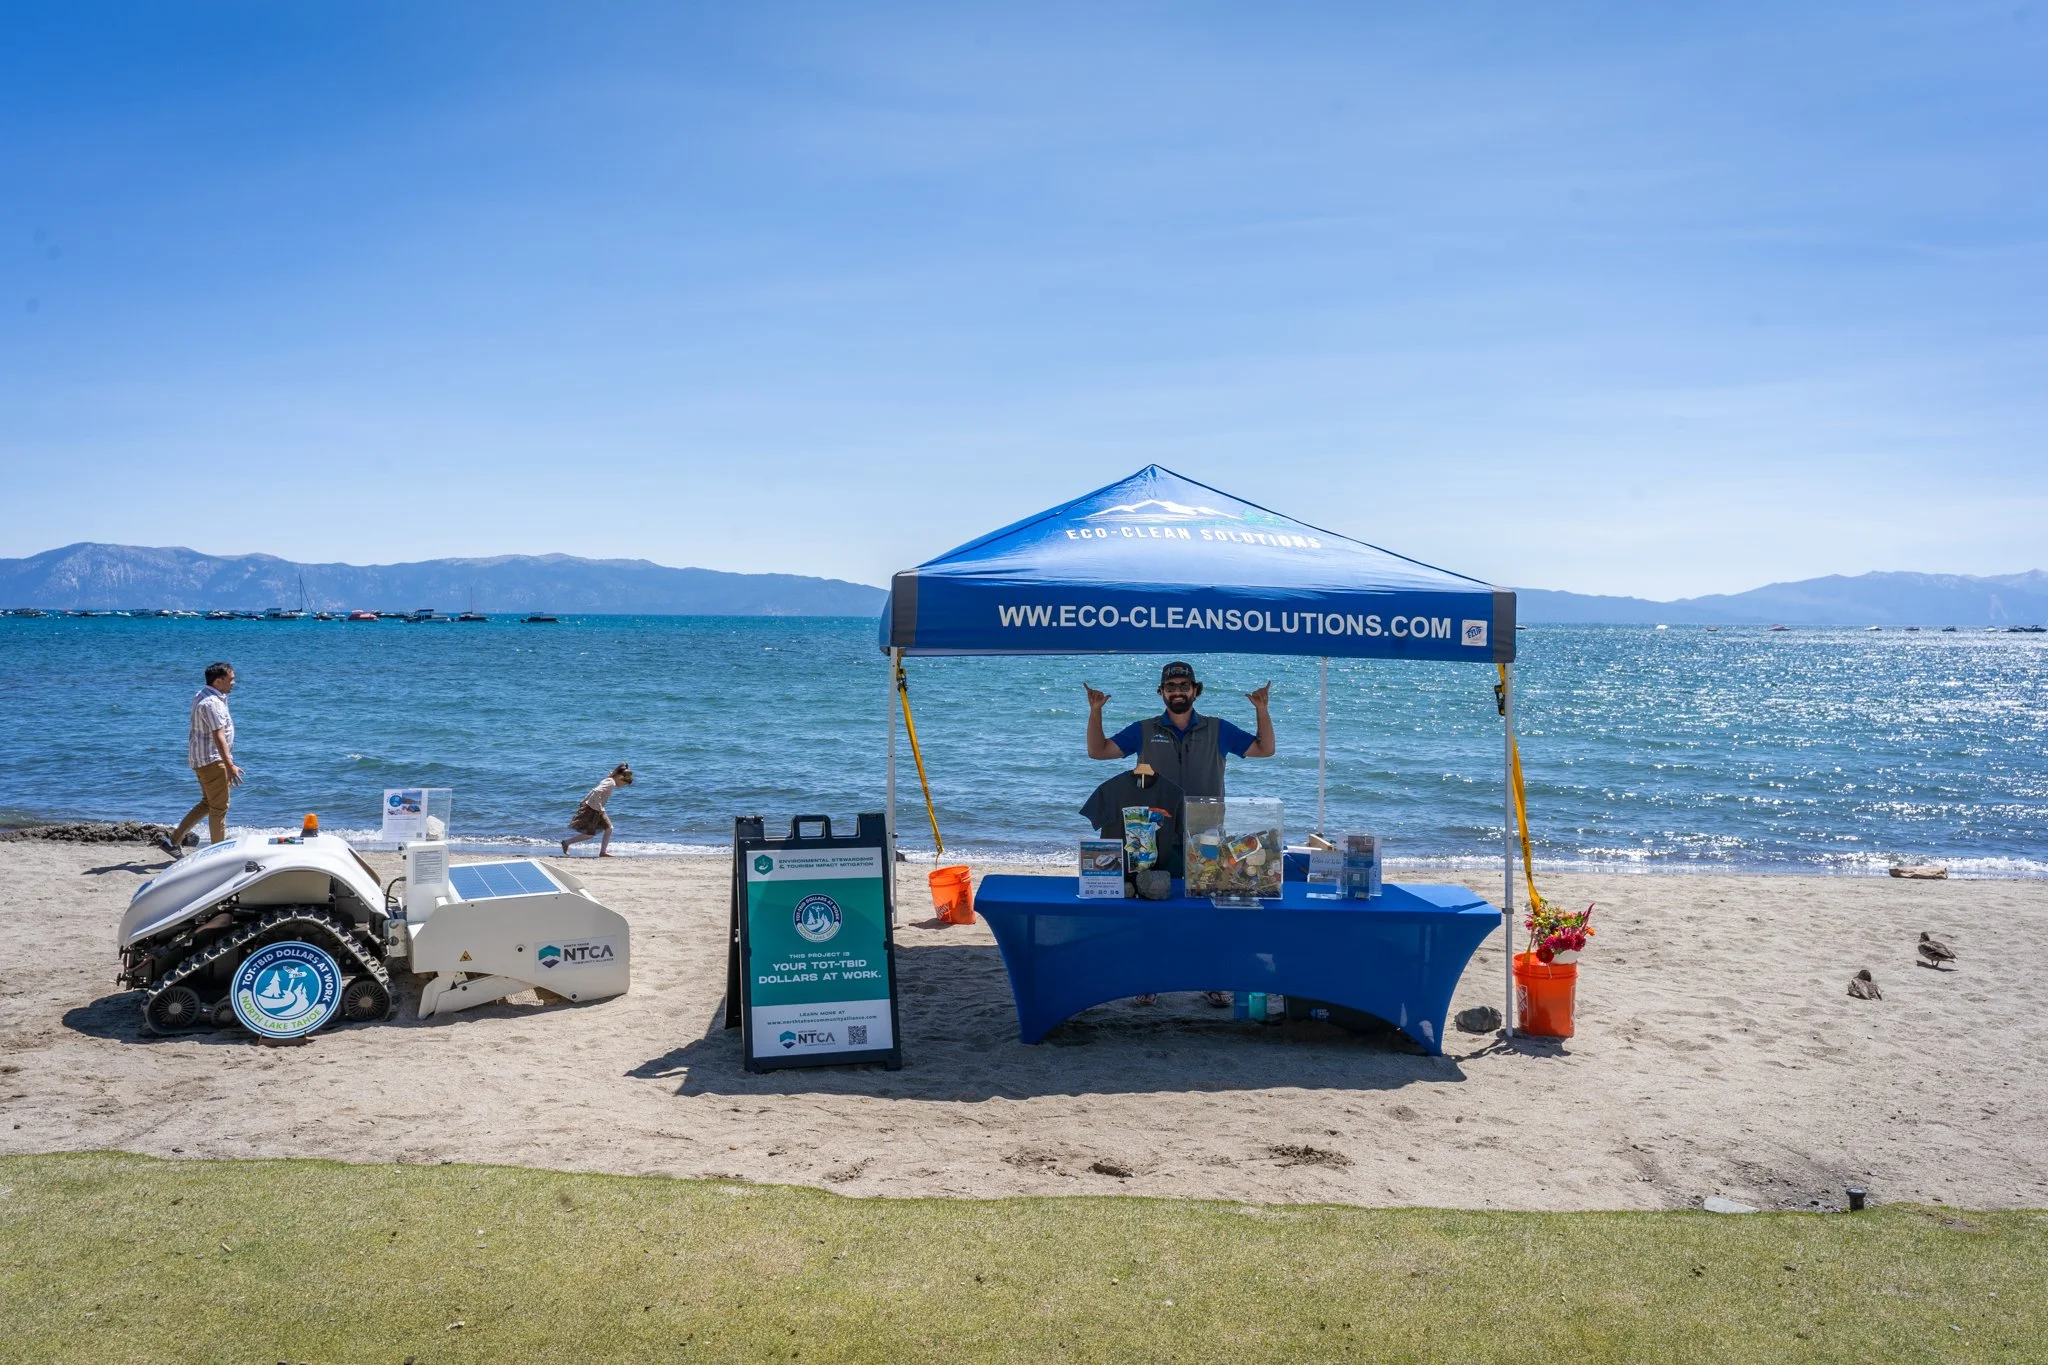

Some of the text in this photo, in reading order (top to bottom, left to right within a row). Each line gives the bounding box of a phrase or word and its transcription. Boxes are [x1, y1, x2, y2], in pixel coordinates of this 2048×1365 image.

[1065, 526, 1322, 549] ECO-CLEAN SOLUTIONS
[998, 604, 1452, 639] WW.ECO-CLEANSOLUTIONS.COM
[564, 944, 614, 962] NTCA
[241, 948, 334, 1002] TOT-TBID DOLLARS AT WORK
[772, 959, 867, 971] YOUR TOT-TBID
[758, 970, 882, 984] DOLLARS AT WORK.
[241, 995, 321, 1030] NORTH LAKE TAHOE
[798, 1031, 836, 1044] NTCA
